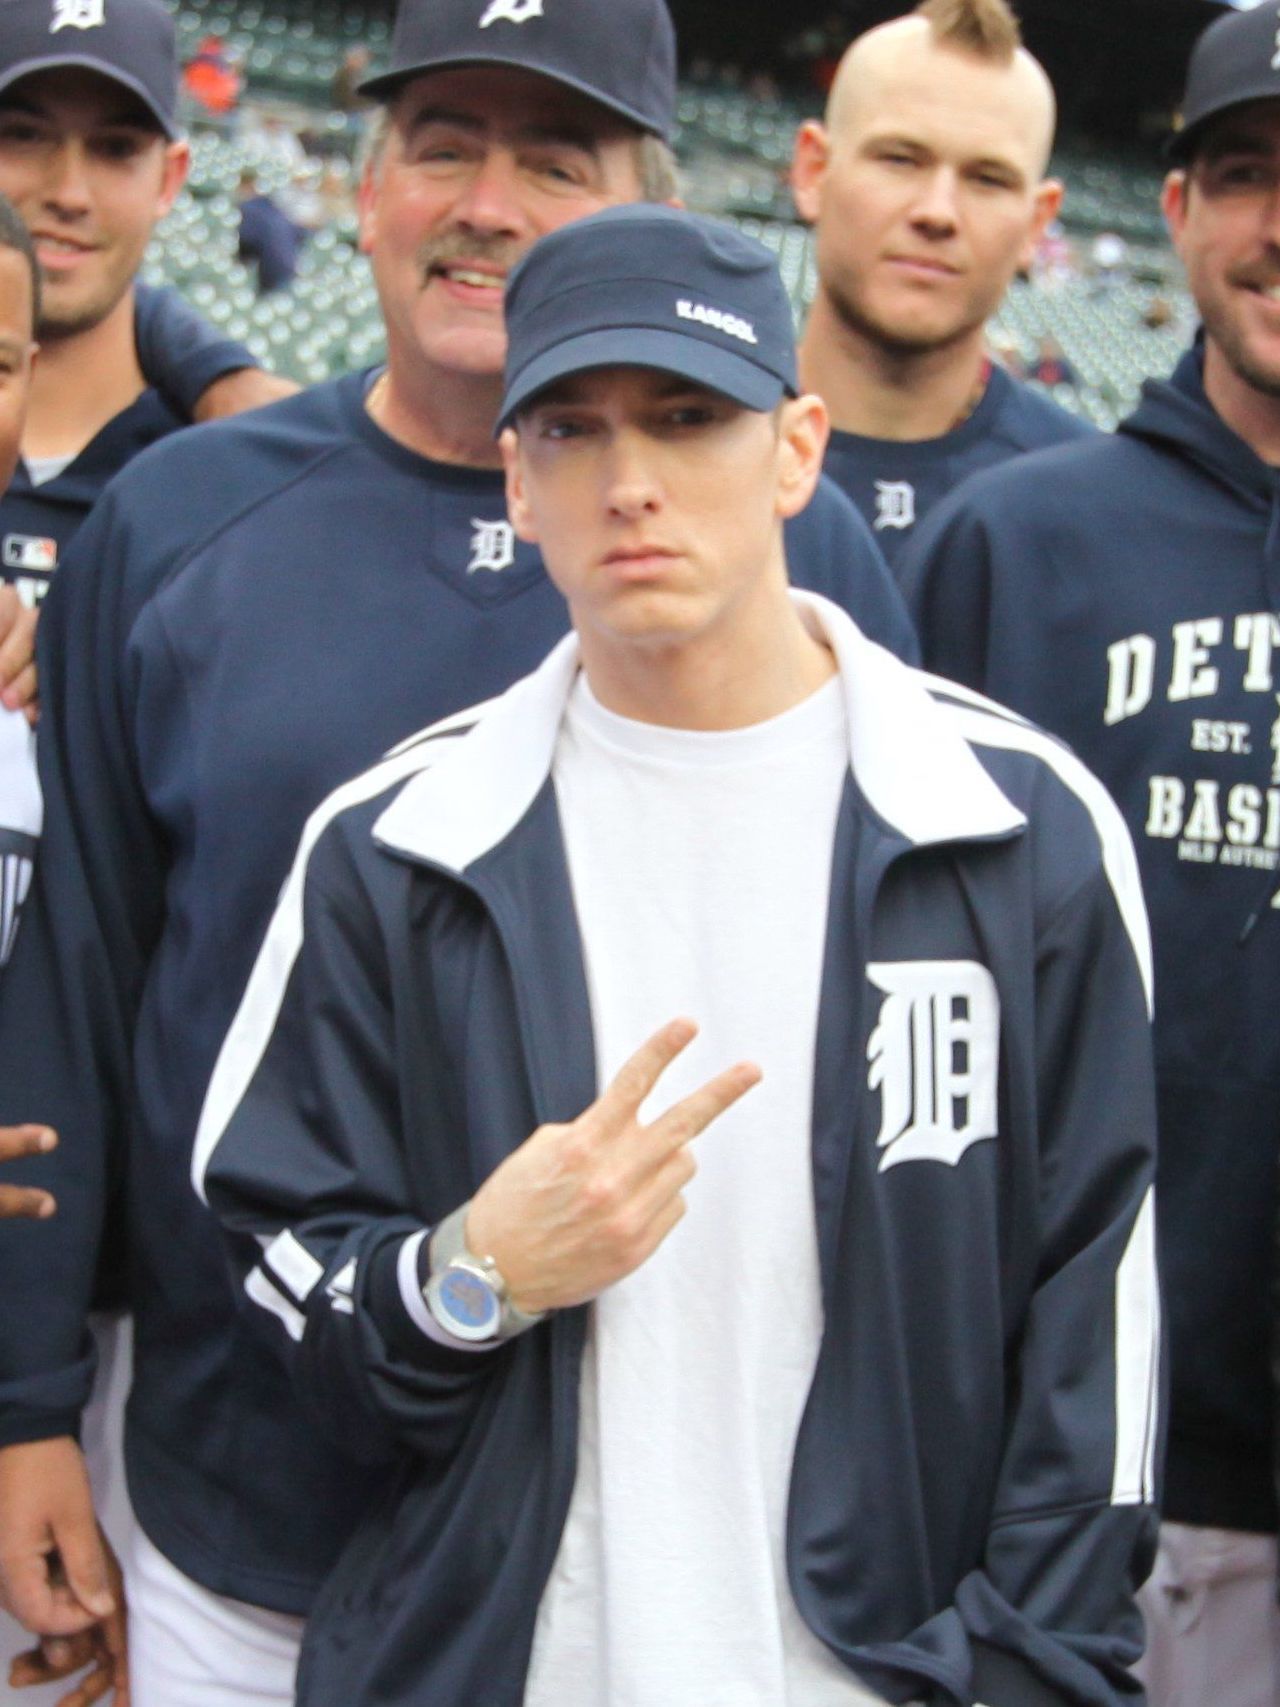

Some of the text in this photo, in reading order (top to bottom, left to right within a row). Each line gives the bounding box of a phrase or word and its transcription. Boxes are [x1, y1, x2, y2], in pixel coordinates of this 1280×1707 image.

[872, 479, 916, 531] D
[465, 516, 515, 575] D
[865, 959, 1001, 1174] D
